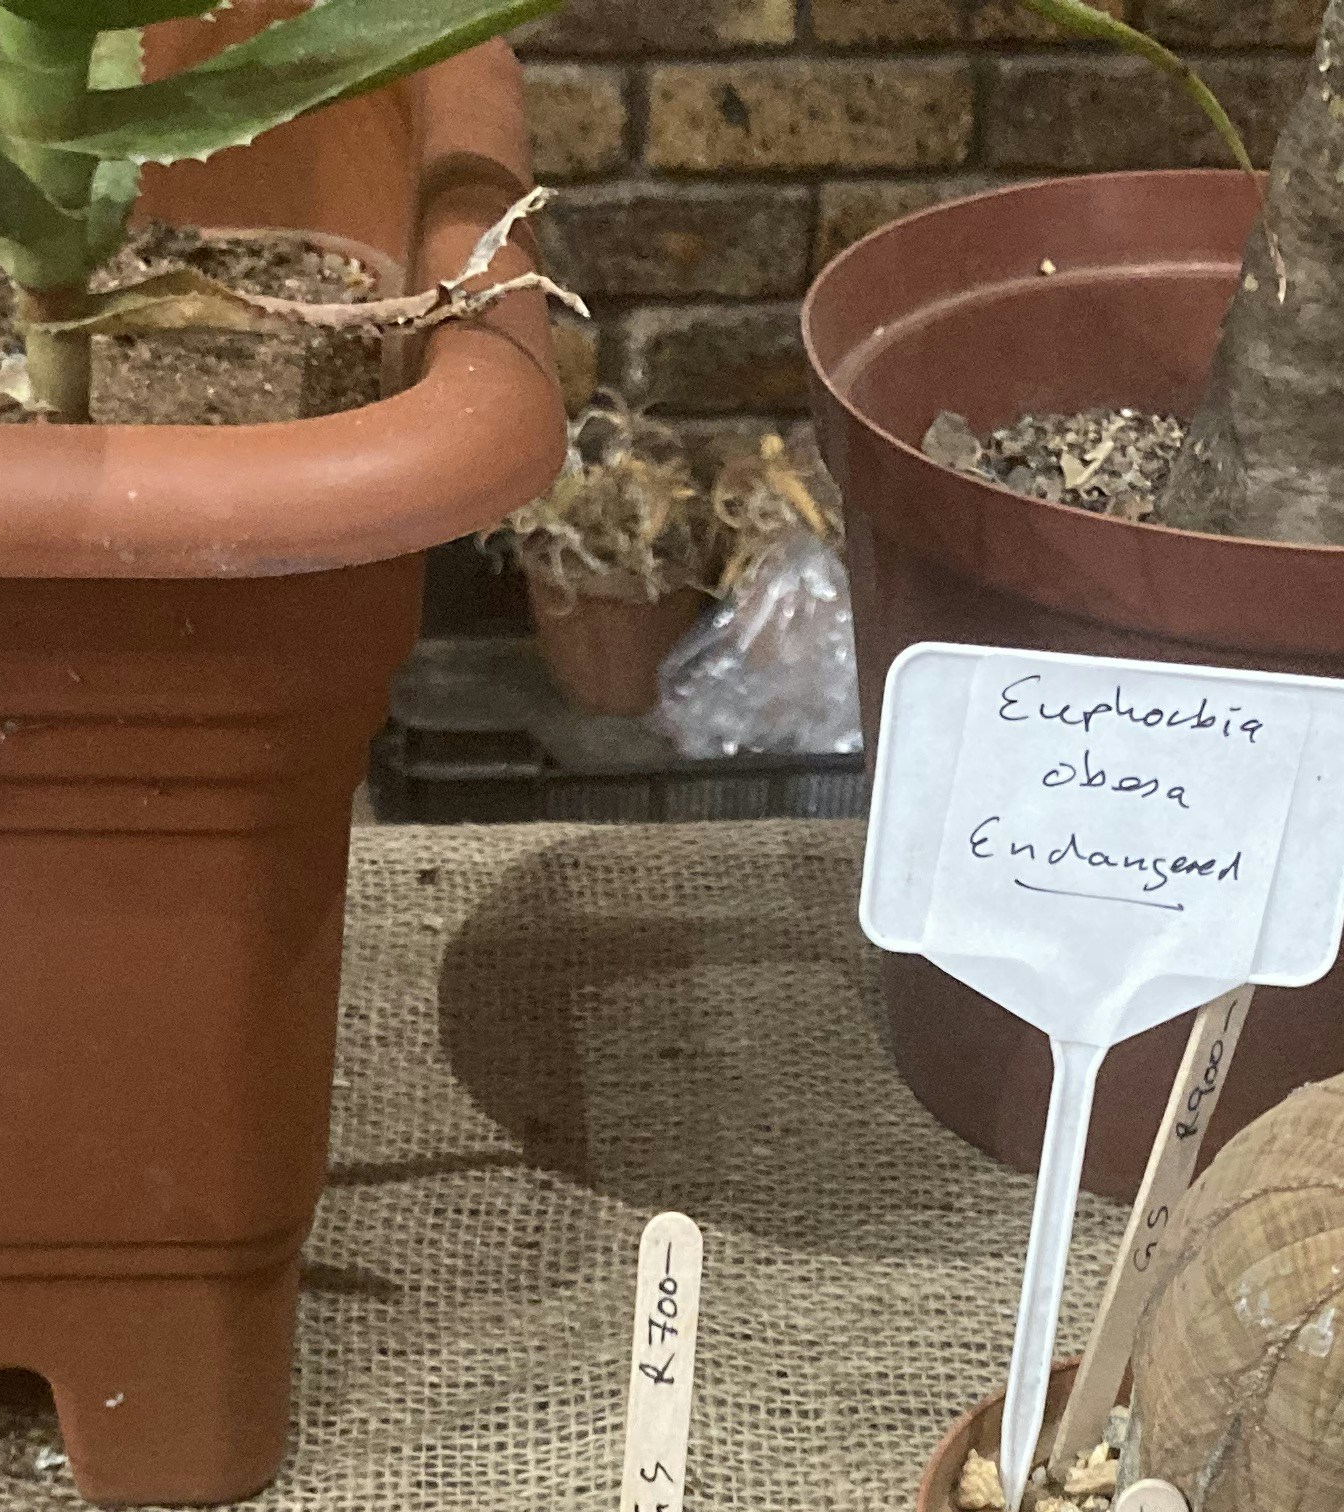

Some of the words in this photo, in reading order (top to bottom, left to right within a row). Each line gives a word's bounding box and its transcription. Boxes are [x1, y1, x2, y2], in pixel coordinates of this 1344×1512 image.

[998, 675, 1265, 744] Euphorbia
[1043, 750, 1191, 809] obesa
[970, 816, 1240, 891] Endangered
